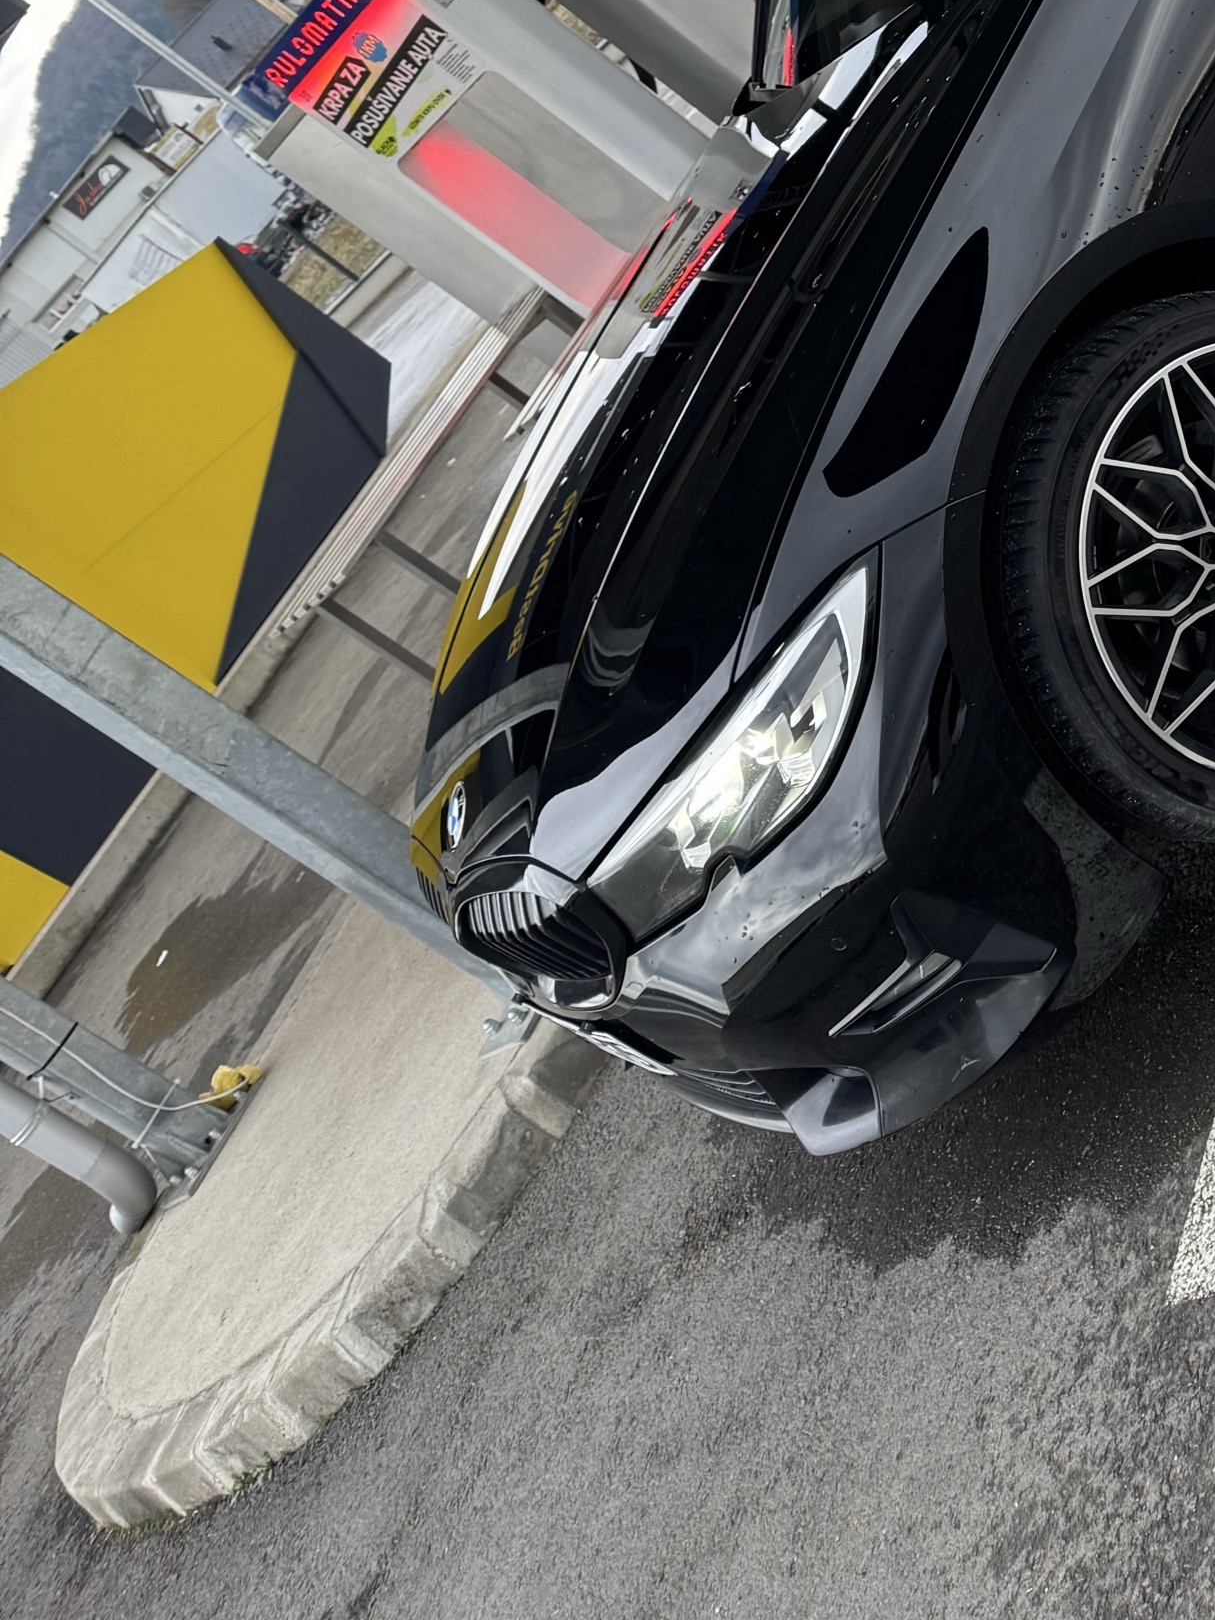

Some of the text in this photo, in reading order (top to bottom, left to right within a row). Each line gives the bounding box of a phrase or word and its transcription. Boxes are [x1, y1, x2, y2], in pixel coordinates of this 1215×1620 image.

[358, 33, 380, 59] 1KM
[318, 61, 367, 121] KRPA ZA
[350, 58, 419, 145] POSUŠIVANJE
[411, 26, 445, 67] AUTA
